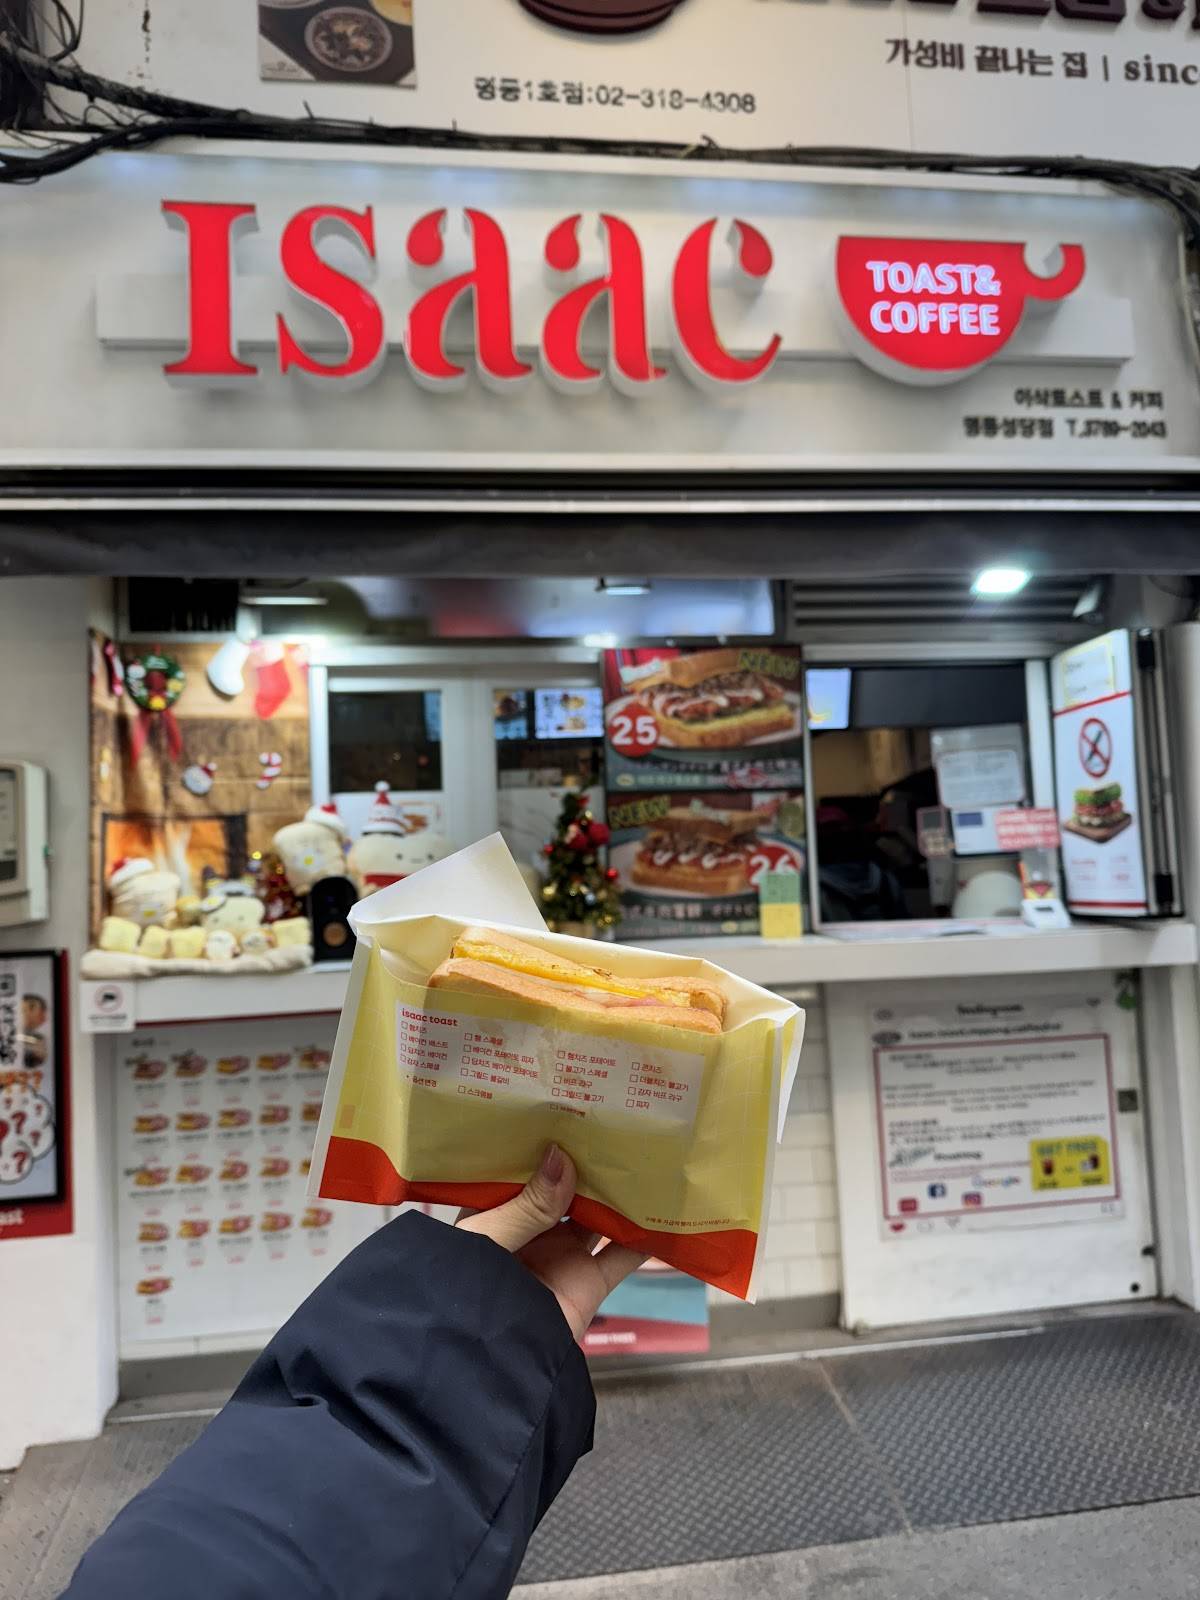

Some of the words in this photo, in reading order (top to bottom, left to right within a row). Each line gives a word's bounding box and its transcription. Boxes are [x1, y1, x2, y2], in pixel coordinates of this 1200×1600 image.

[885, 37, 965, 71] 가성비
[974, 44, 1054, 77] 끝나는
[1061, 50, 1089, 78] 집
[869, 300, 1001, 336] COFFEE
[1014, 386, 1103, 409] 이삭토스트
[1128, 390, 1164, 410] 커피
[611, 715, 658, 746] 25
[402, 1008, 428, 1022] isaac
[429, 1016, 458, 1027] toast
